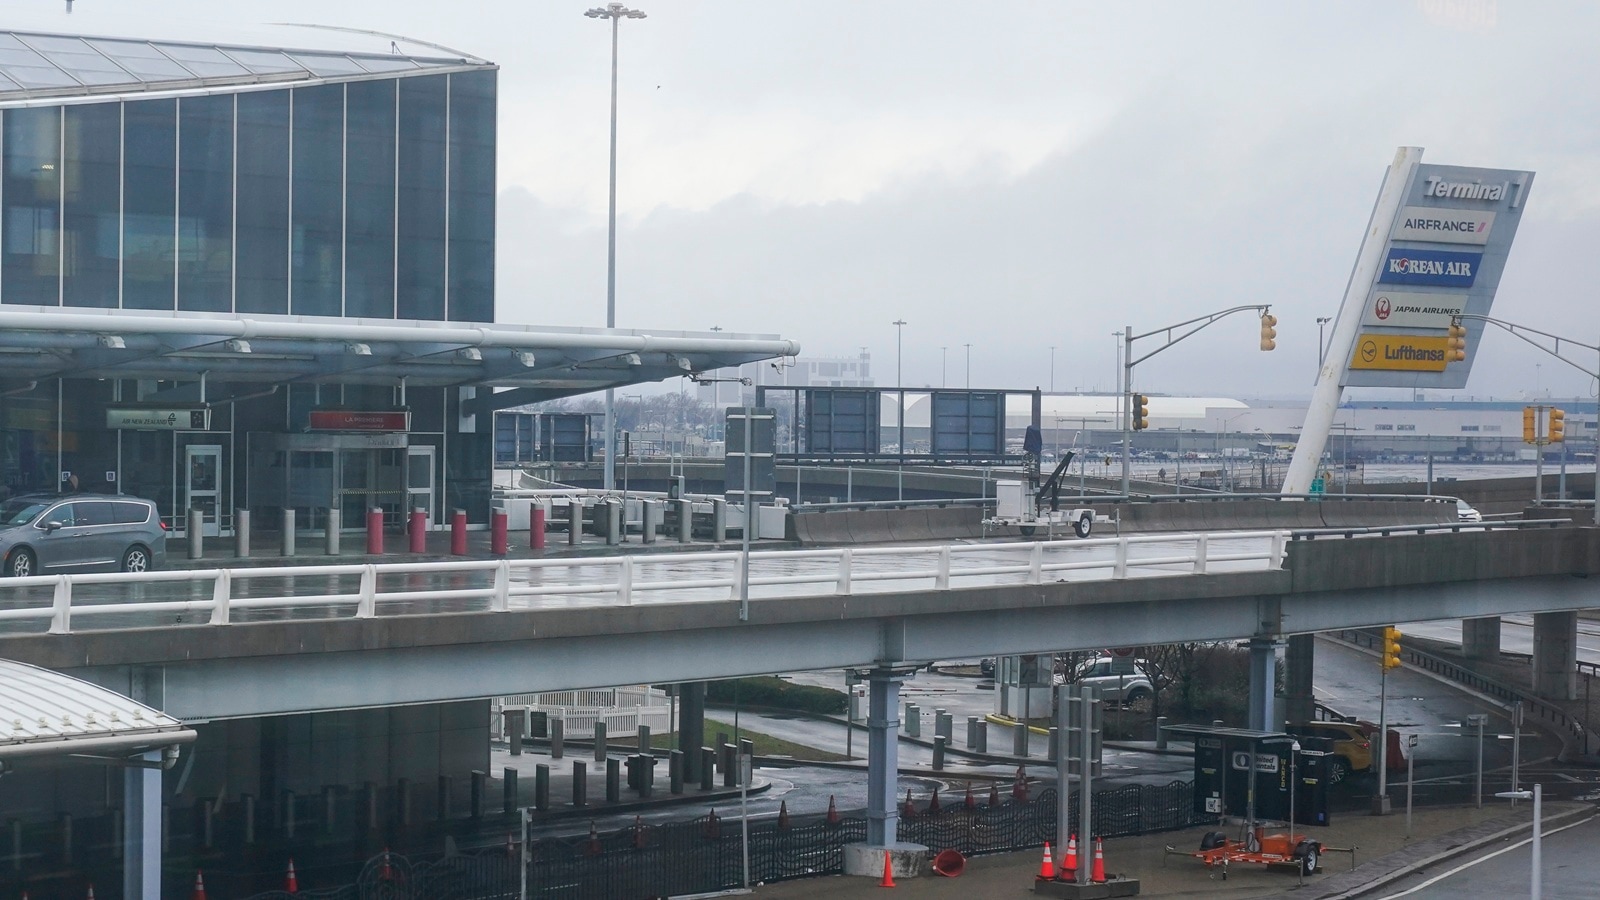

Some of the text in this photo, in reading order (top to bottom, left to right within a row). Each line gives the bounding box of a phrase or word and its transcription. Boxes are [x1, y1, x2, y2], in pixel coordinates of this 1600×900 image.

[1425, 172, 1529, 209] Terminal 1
[1404, 218, 1475, 232] AIRFRANCE
[1389, 257, 1471, 277] KOREAN AIR
[1394, 305, 1461, 315] JAPAN AIRLINES
[1385, 345, 1445, 361] Lufthansa
